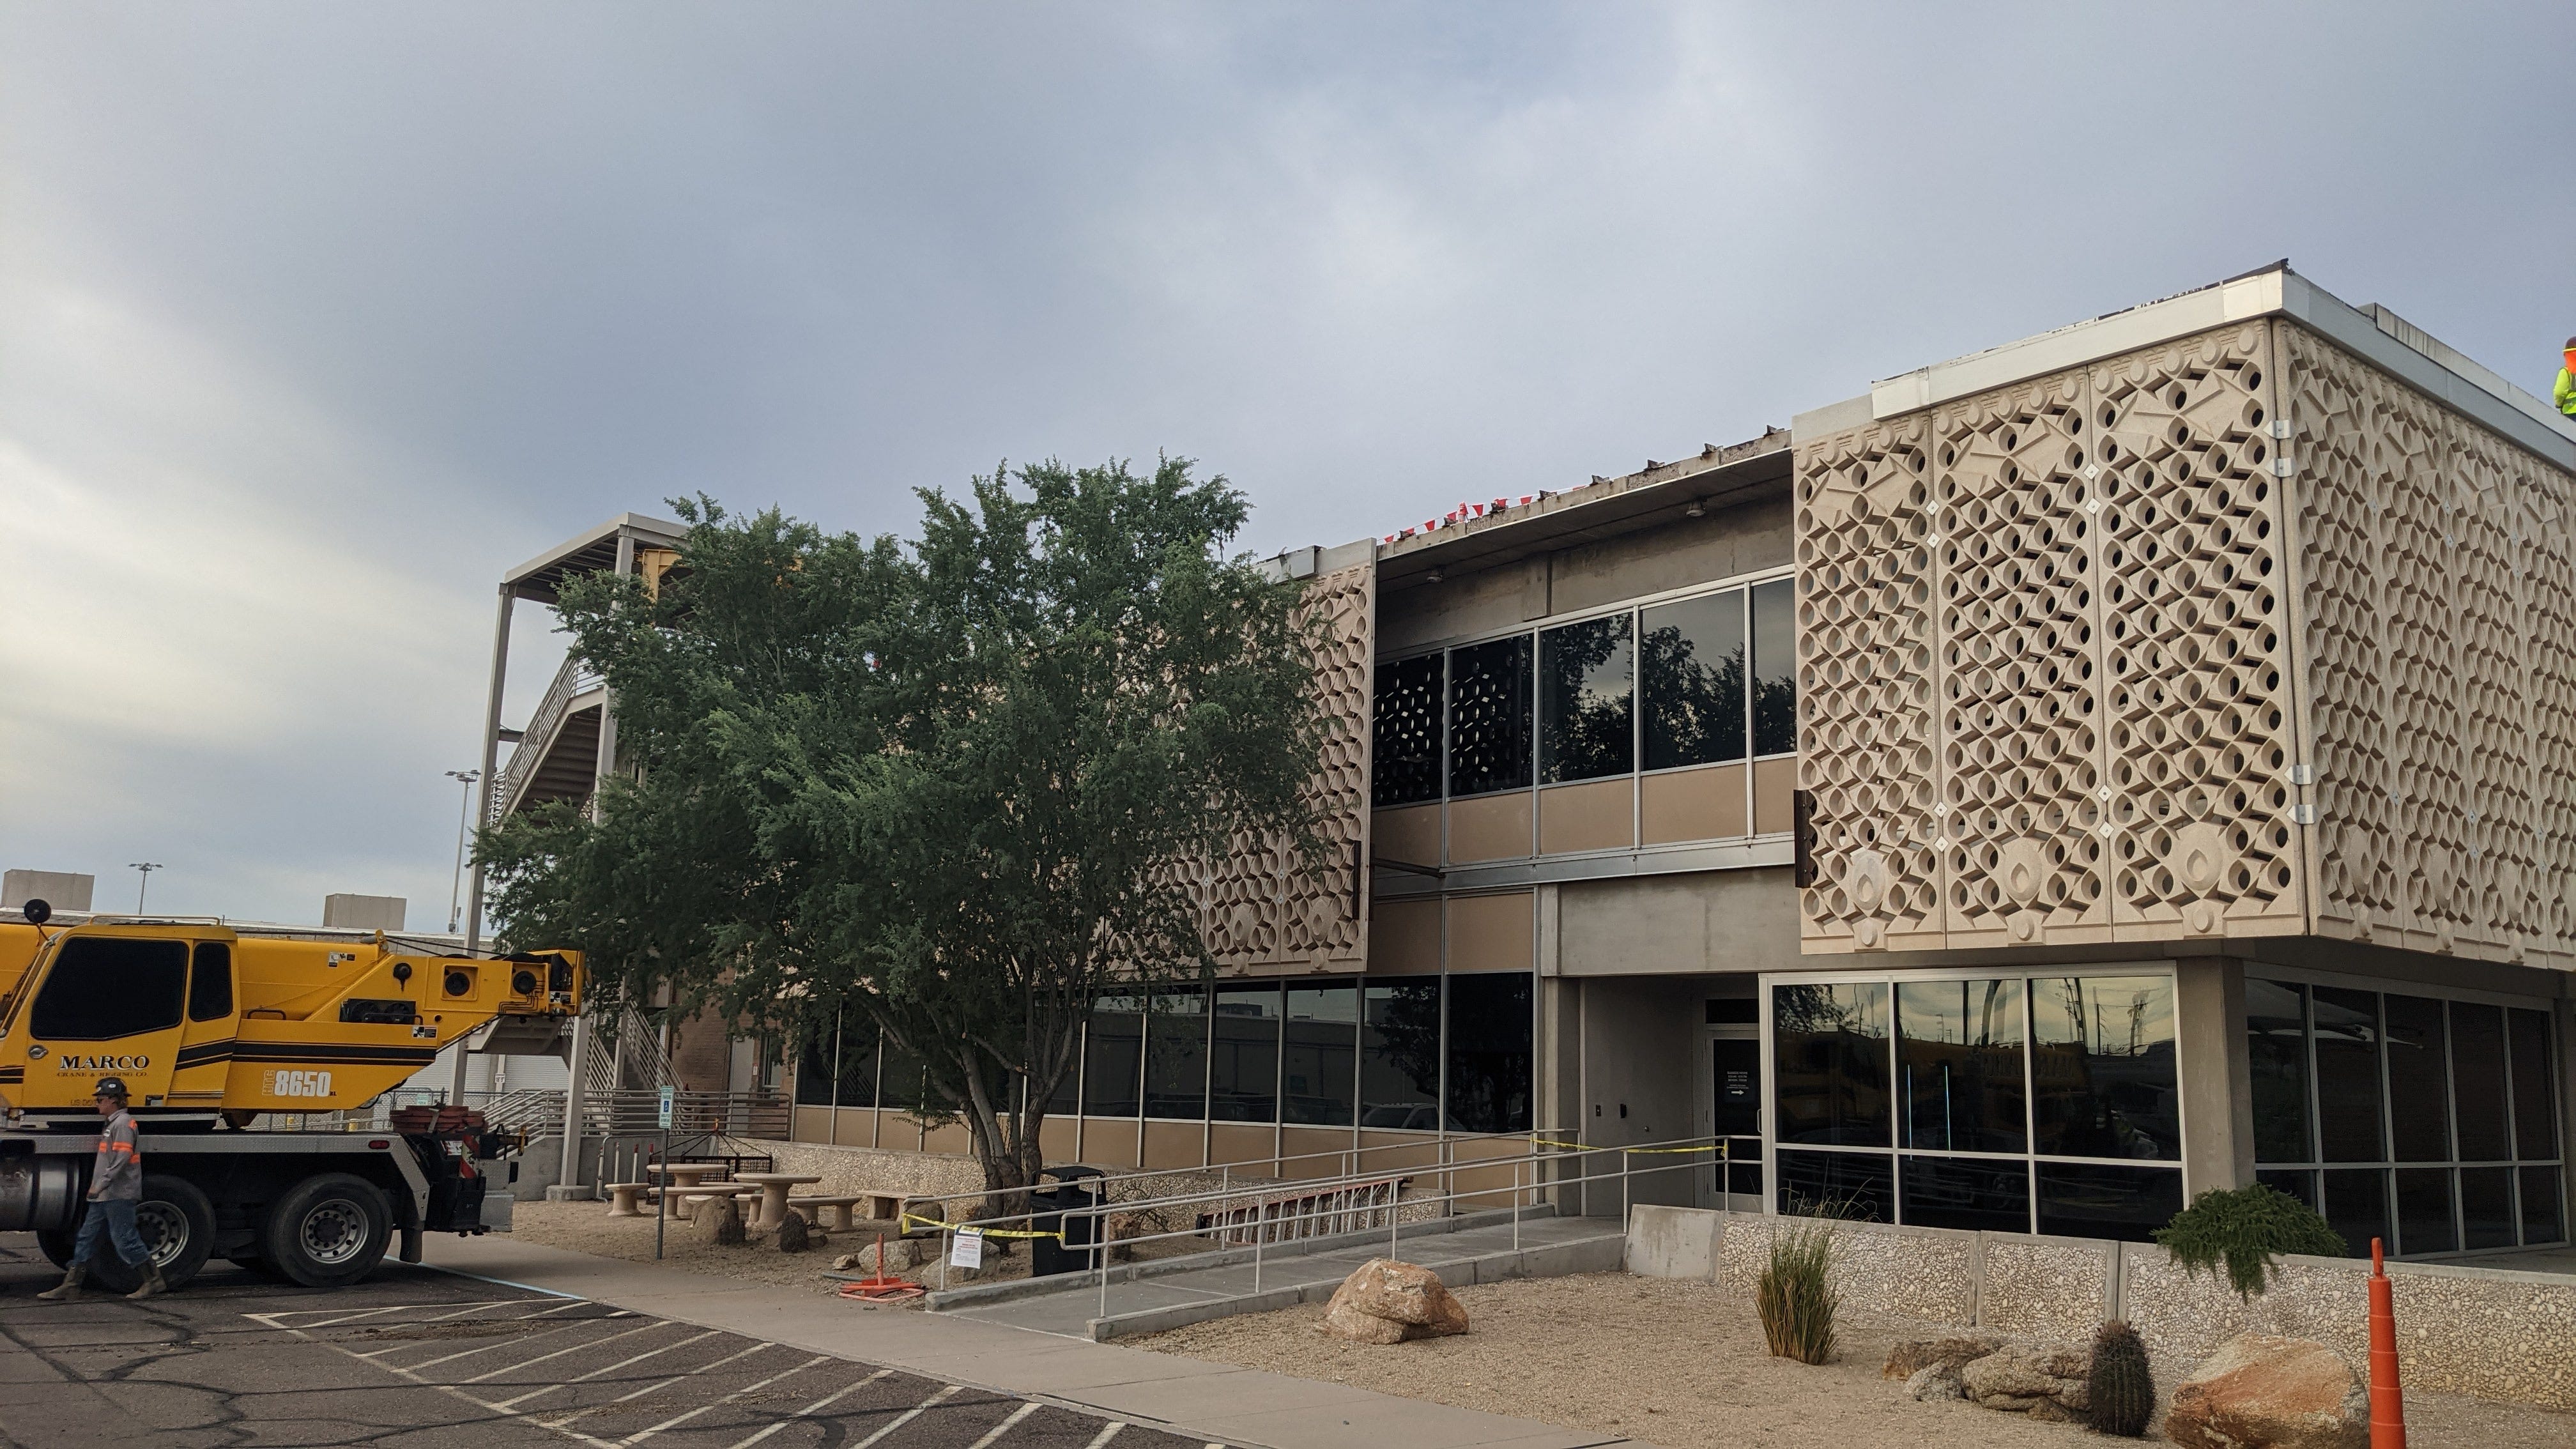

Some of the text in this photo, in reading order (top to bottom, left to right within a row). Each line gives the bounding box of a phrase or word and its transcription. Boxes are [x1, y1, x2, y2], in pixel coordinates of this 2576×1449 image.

[60, 1055, 150, 1070] MARCO
[262, 1070, 275, 1096] HTC
[275, 1070, 331, 1097] 8650
